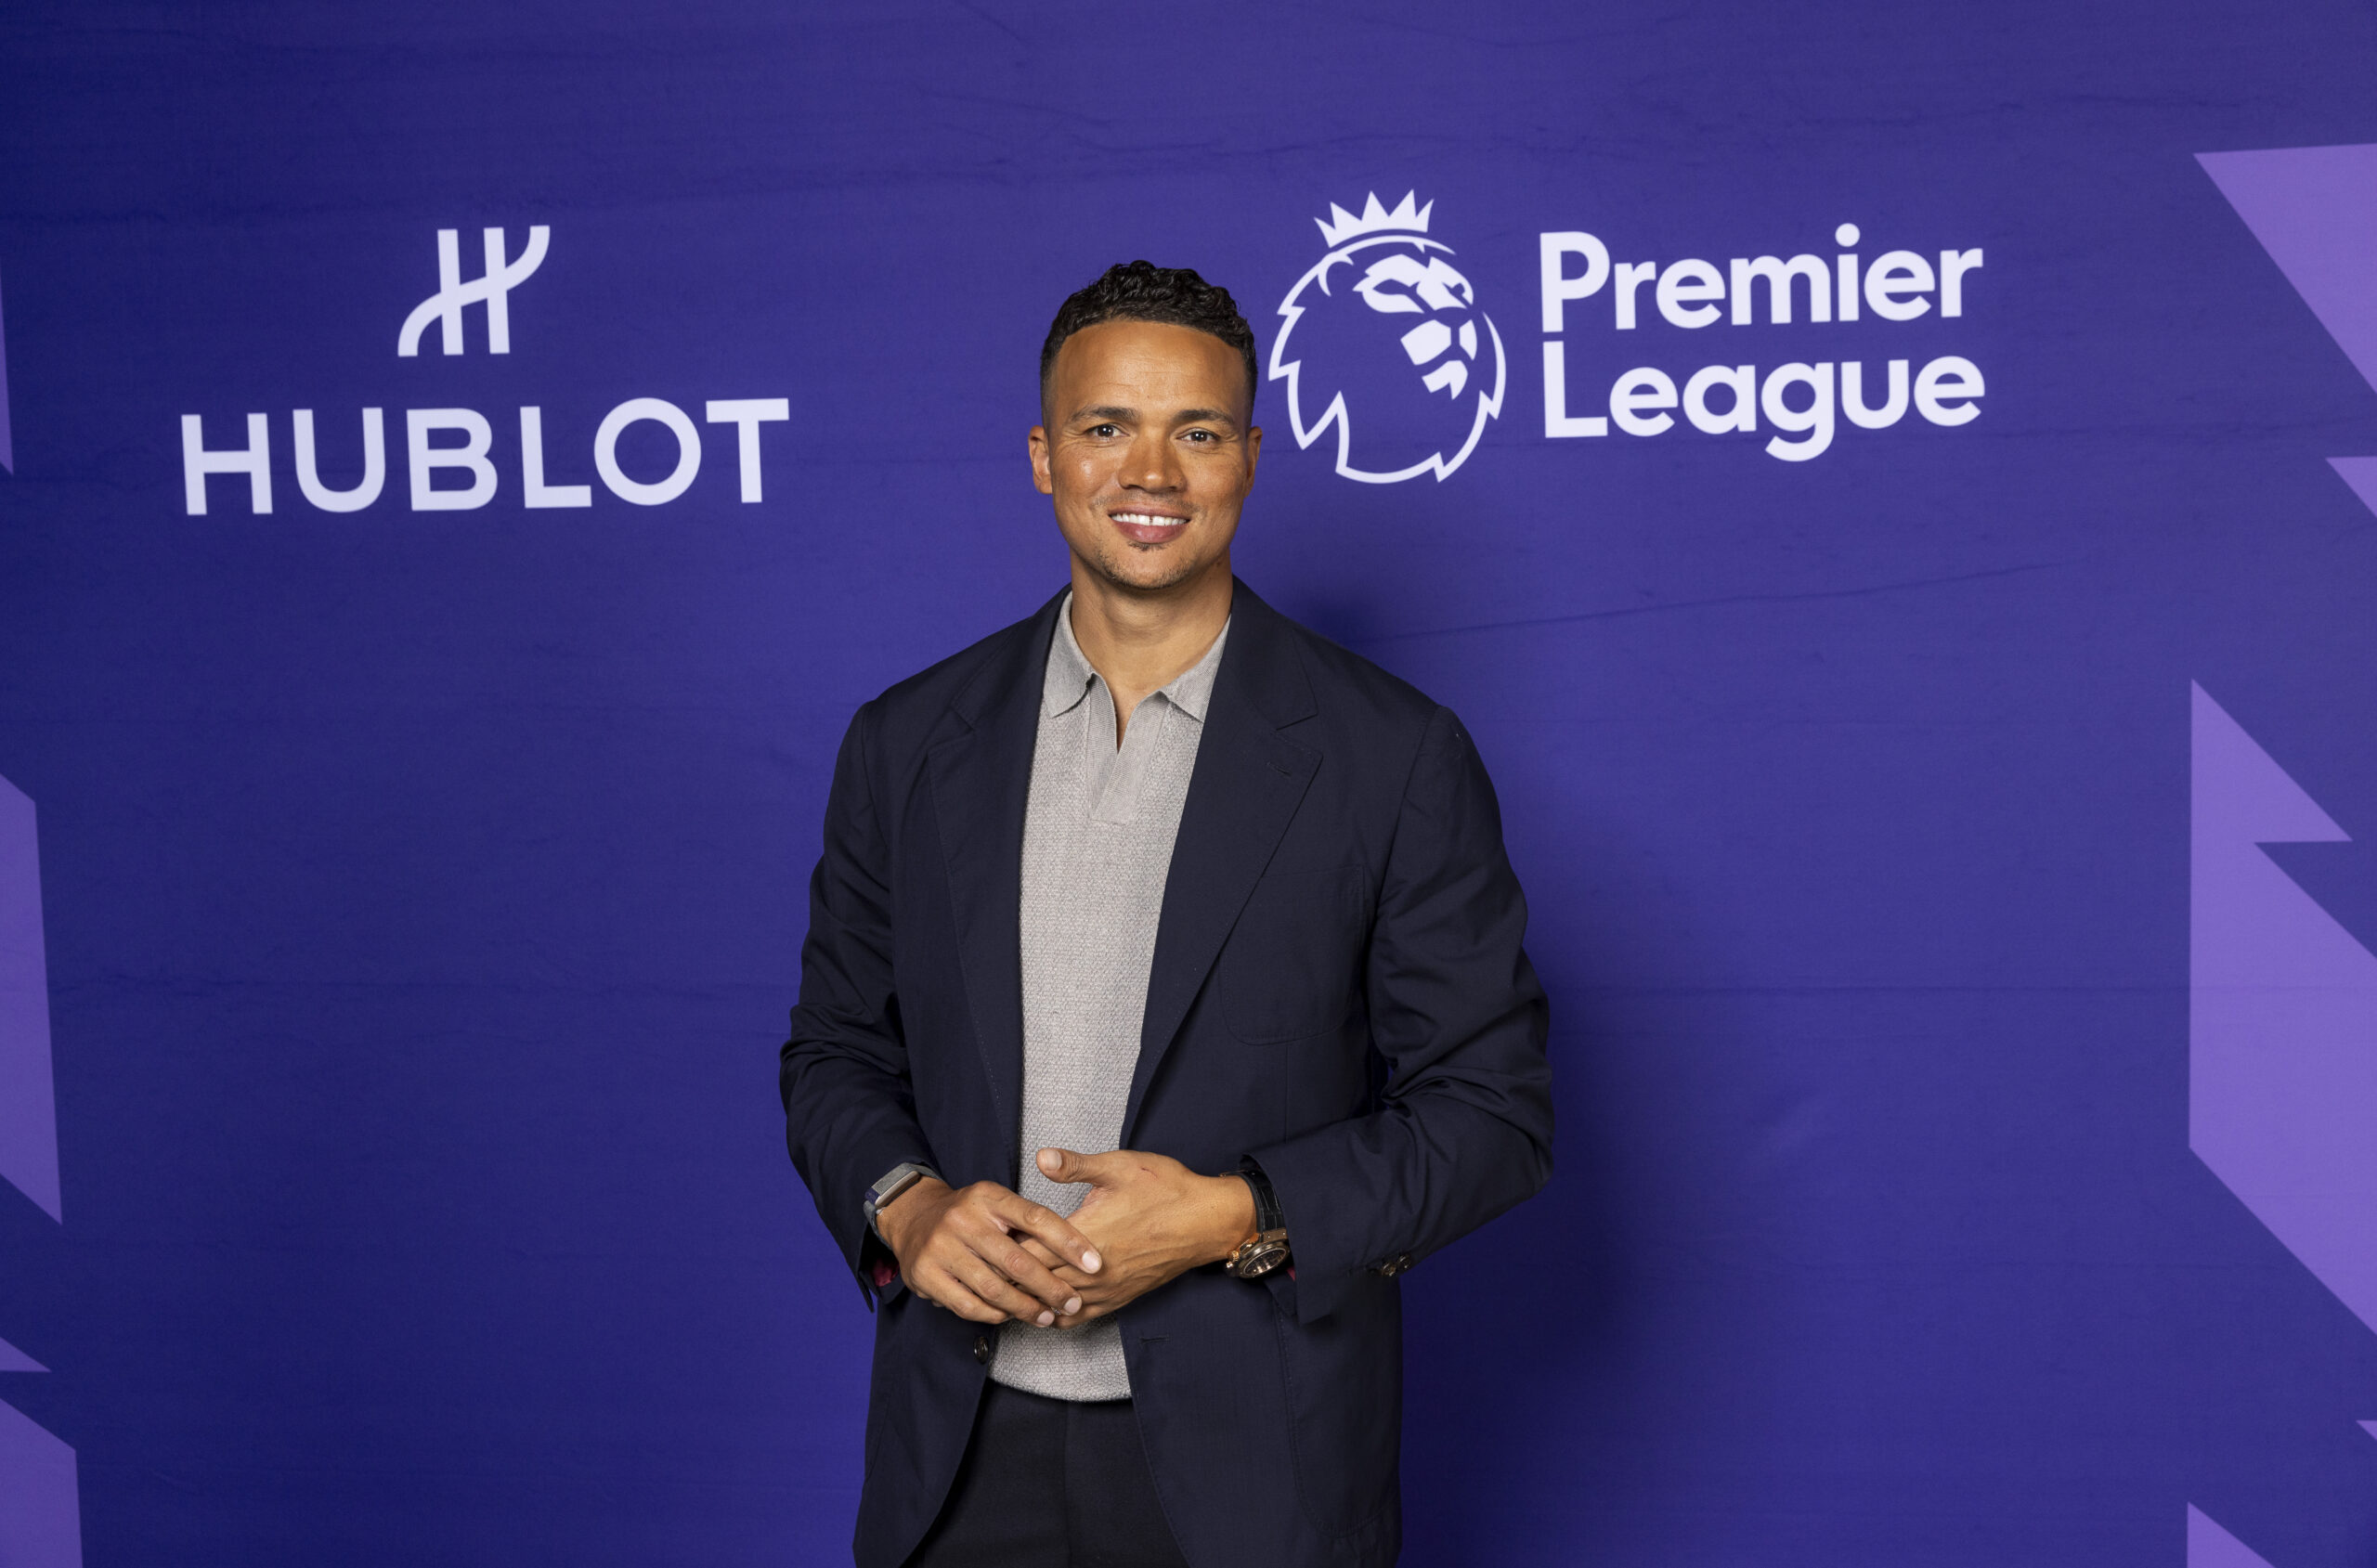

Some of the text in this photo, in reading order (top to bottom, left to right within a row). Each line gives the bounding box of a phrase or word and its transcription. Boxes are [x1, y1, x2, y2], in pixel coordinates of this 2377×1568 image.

[1539, 223, 1984, 333] Premier
[181, 397, 791, 516] HUBLOT
[1542, 340, 1985, 462] League
